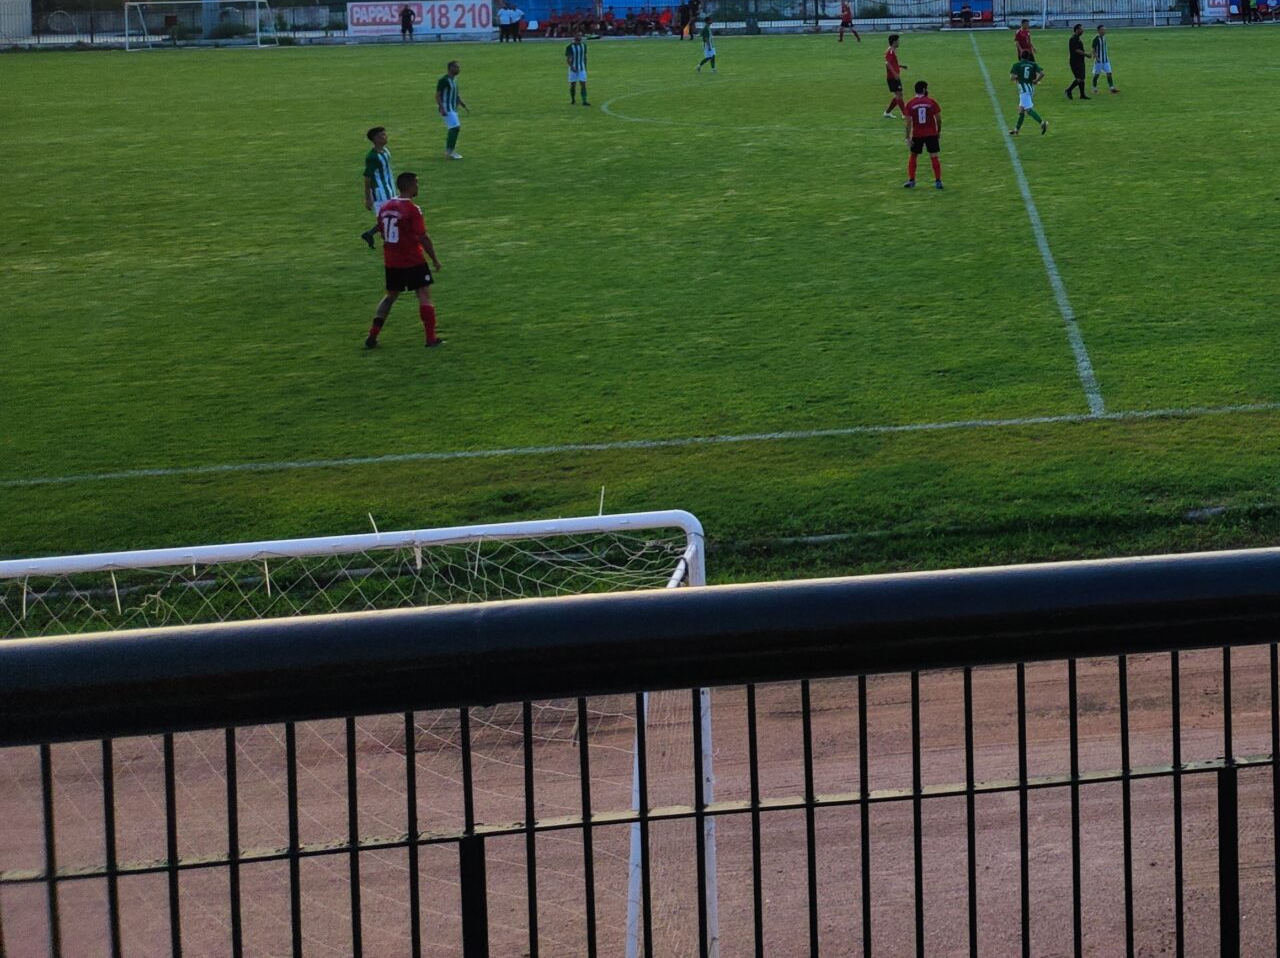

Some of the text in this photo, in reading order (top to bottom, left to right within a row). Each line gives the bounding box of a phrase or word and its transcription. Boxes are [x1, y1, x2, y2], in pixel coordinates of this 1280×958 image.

[352, 5, 399, 23] PAPPAS
[427, 4, 450, 29] 18
[454, 3, 490, 29] 210
[382, 217, 399, 243] 16
